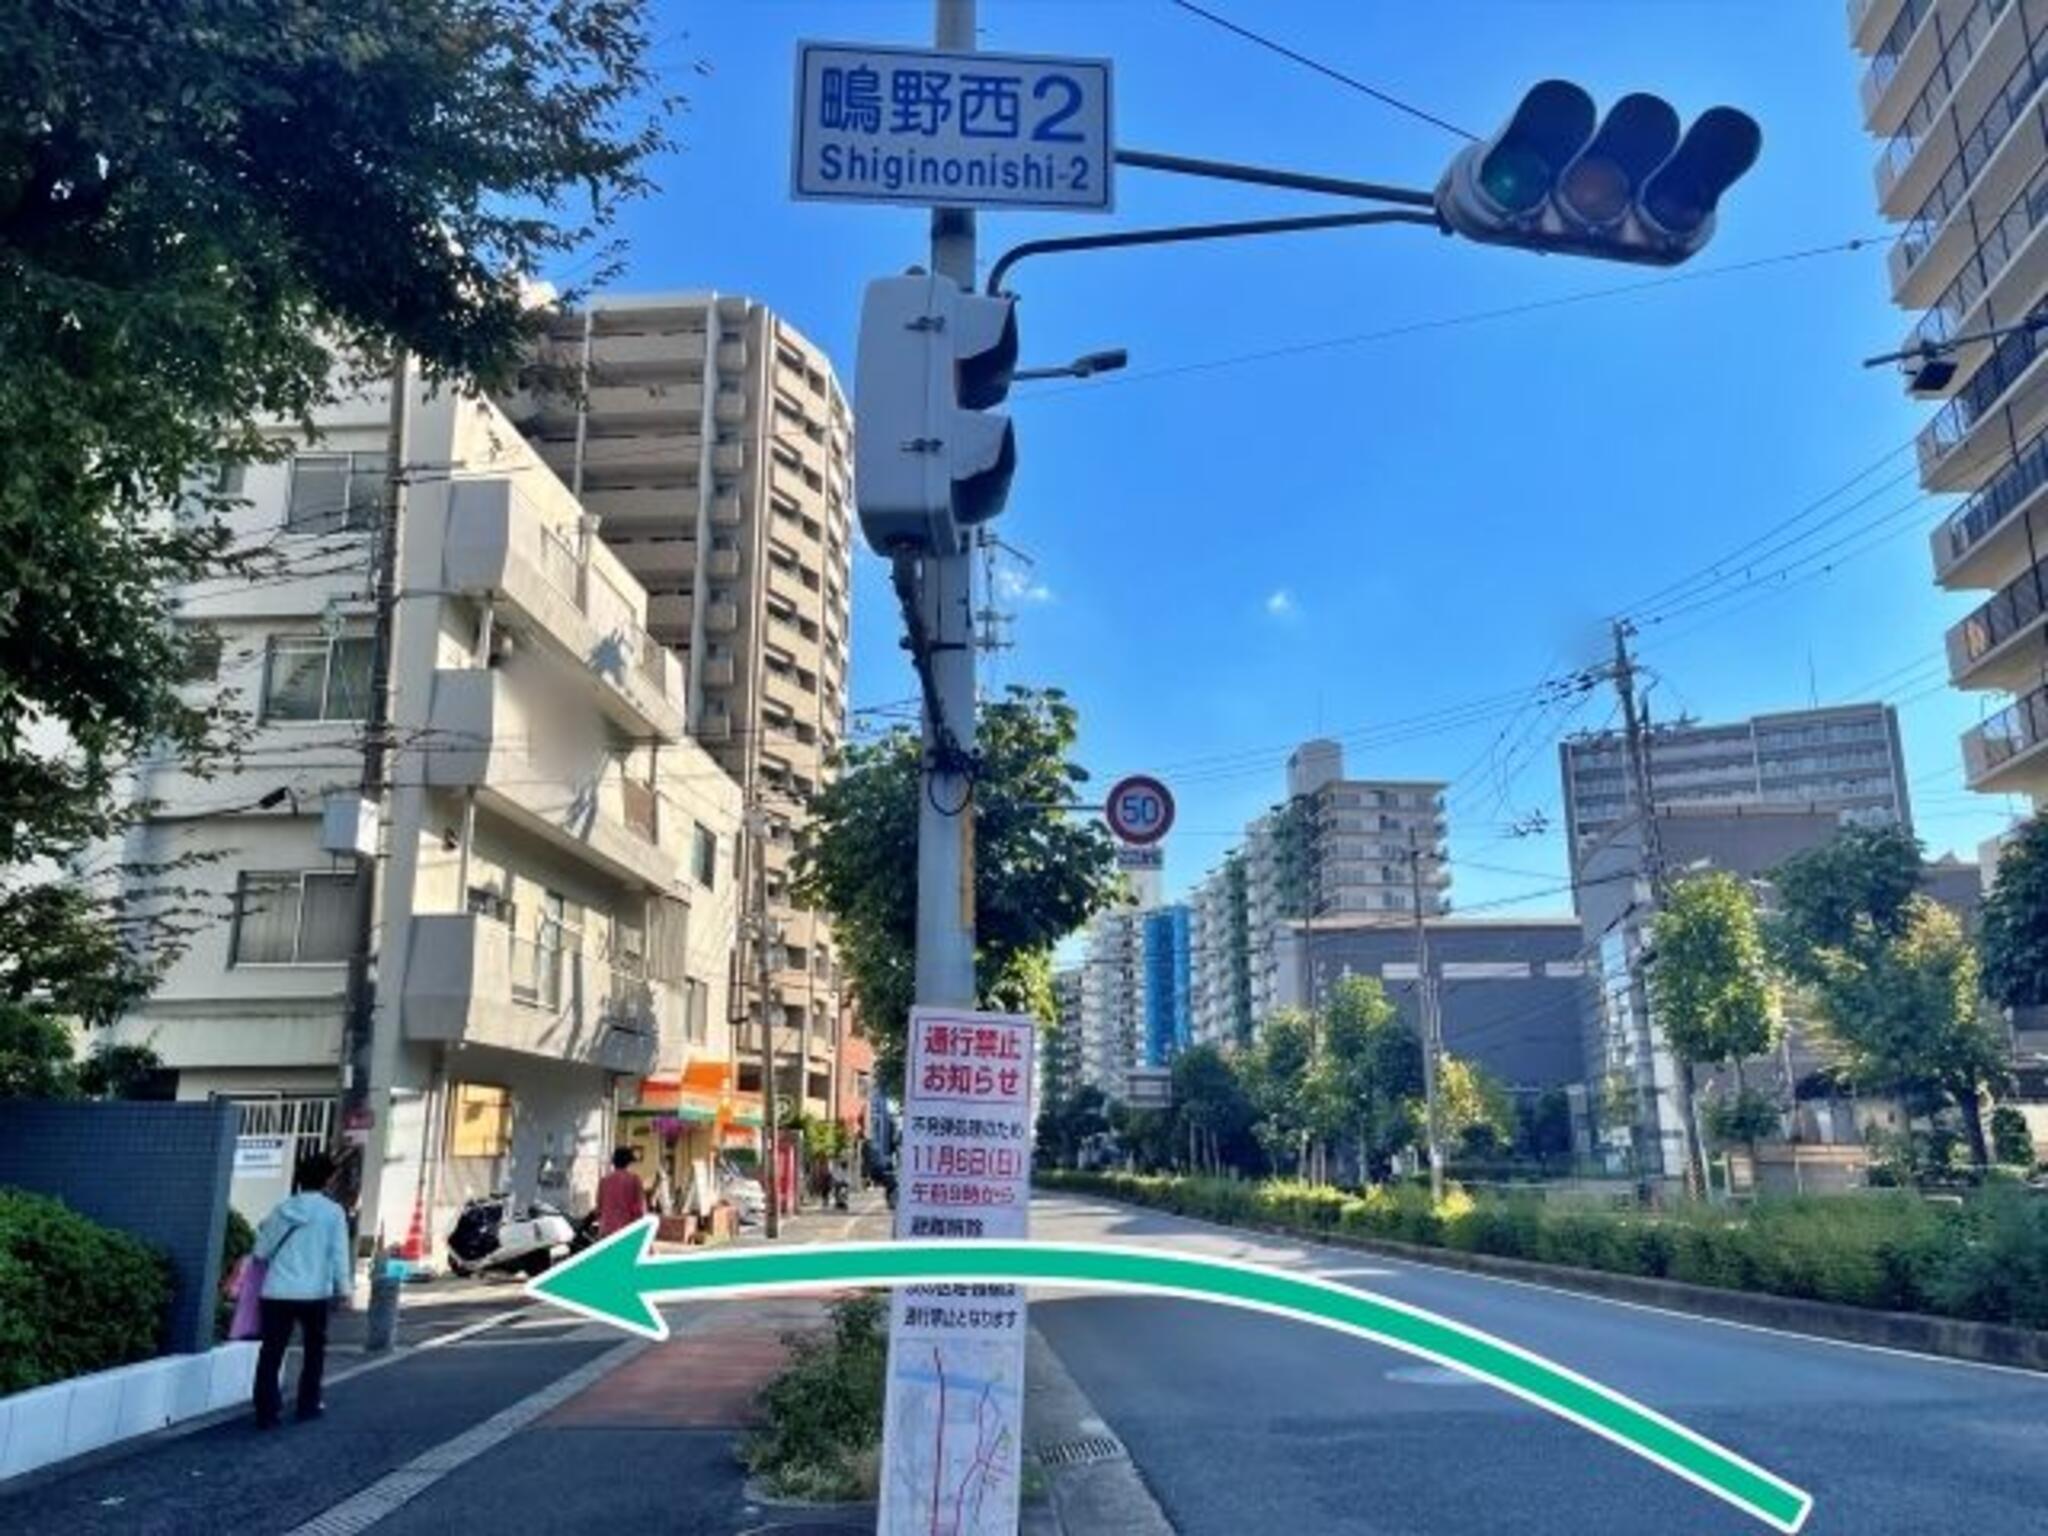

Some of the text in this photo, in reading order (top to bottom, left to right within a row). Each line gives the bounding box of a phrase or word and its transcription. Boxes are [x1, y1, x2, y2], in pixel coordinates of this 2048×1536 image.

[820, 63, 1086, 142] 鴫野西2
[820, 143, 1090, 190] Shiginonishi-2
[1123, 795, 1159, 824] 50
[923, 1025, 1021, 1059] 通行禁止
[923, 1063, 1019, 1095] お知らせ
[911, 1182, 1016, 1205] 午前9時から
